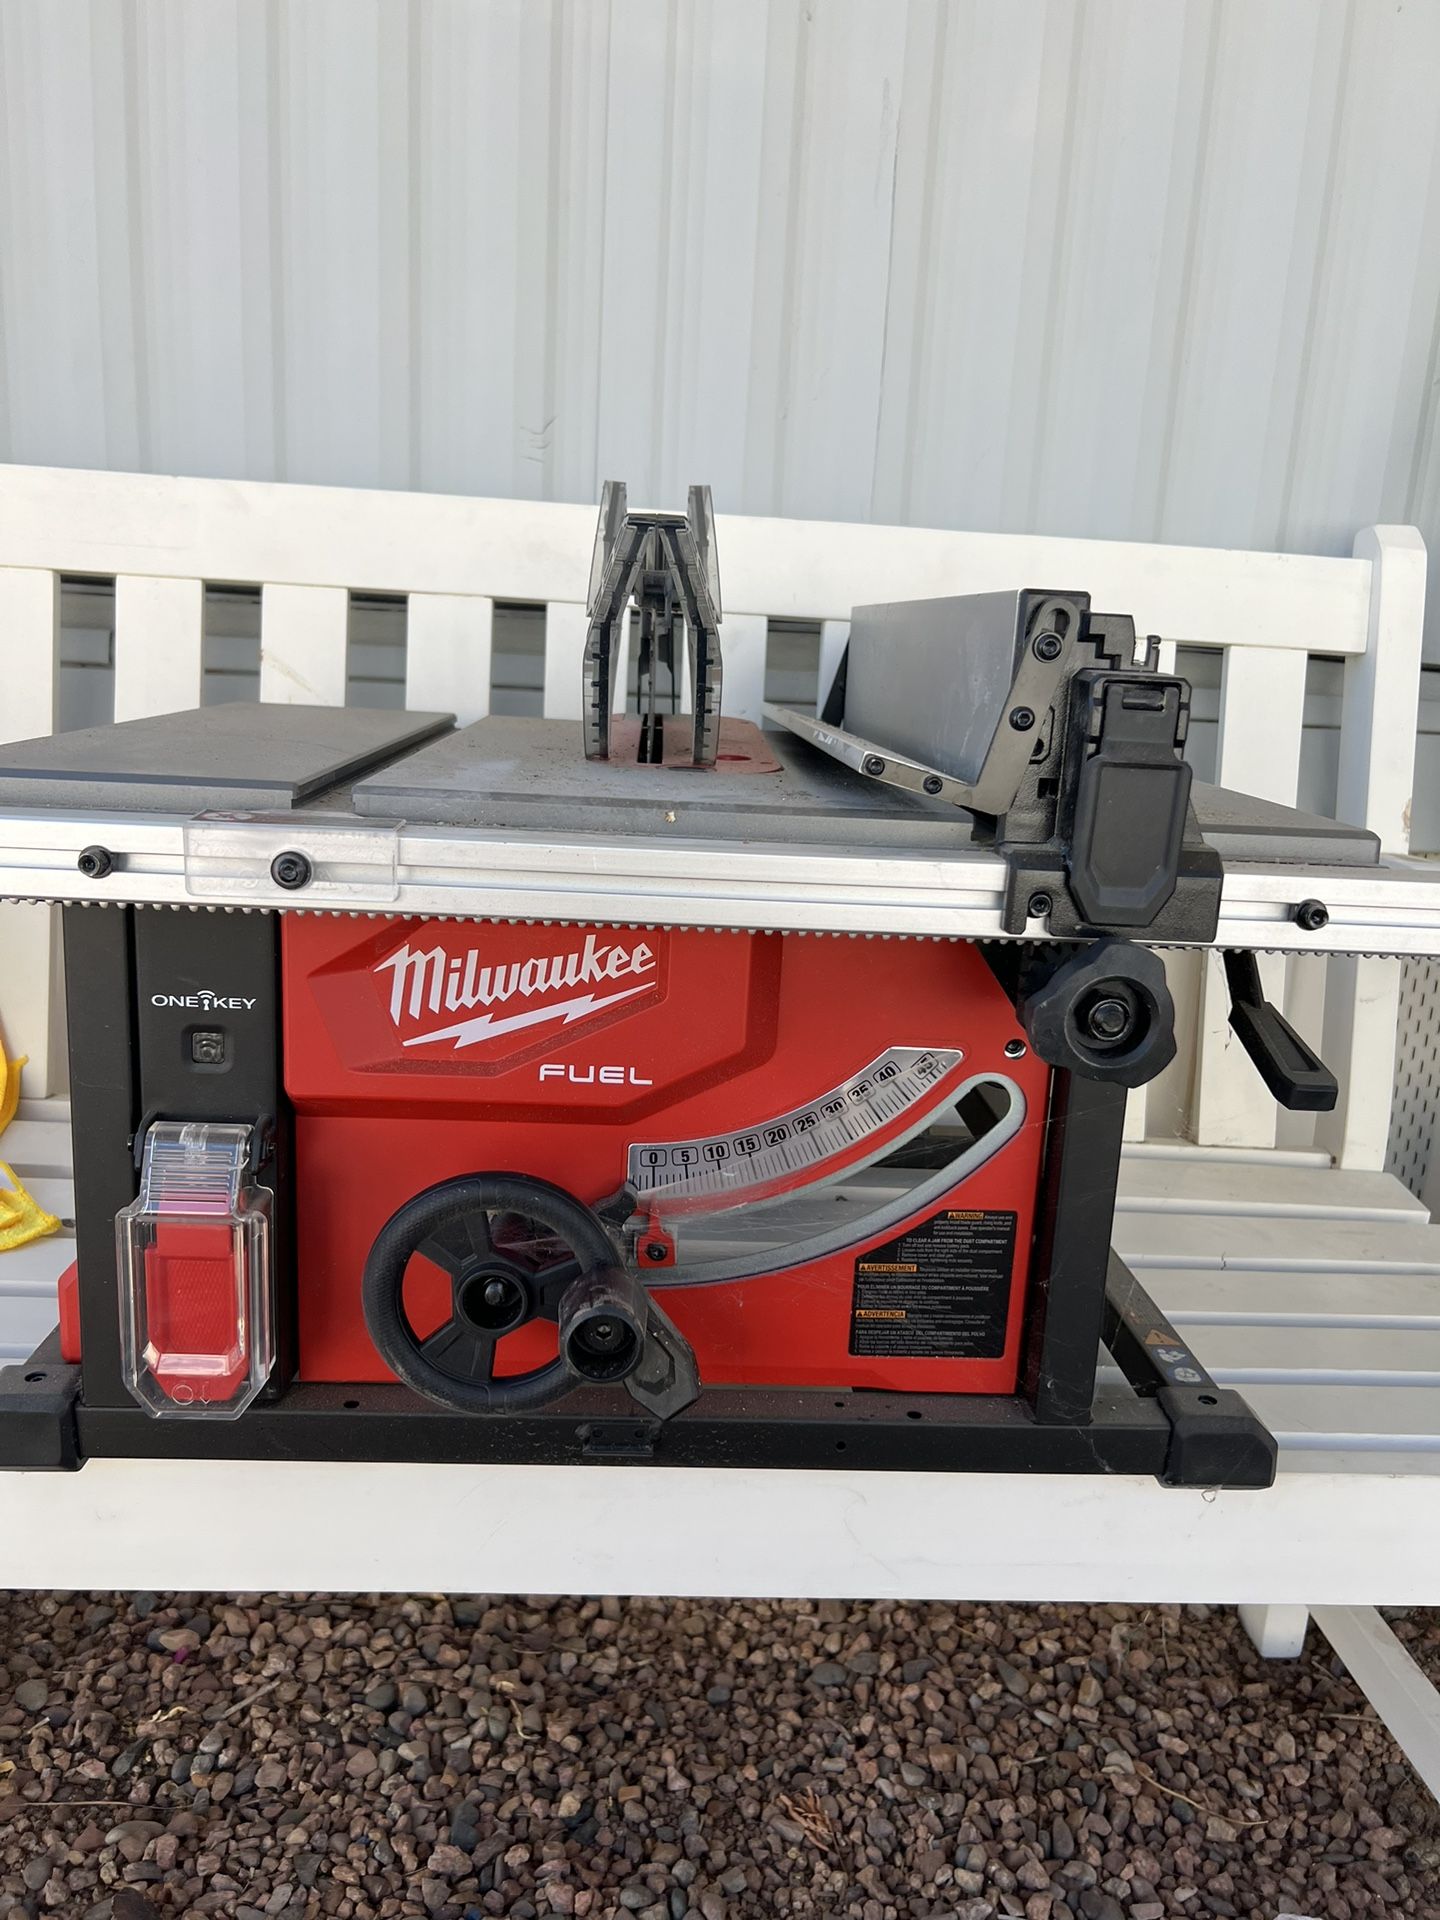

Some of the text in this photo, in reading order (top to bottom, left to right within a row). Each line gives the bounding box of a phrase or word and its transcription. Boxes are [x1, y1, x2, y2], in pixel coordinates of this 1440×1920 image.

[374, 934, 656, 1027] Milwaukee
[539, 1064, 653, 1085] FUEL
[649, 1151, 658, 1164] 0
[681, 1150, 690, 1163] 5
[708, 1145, 725, 1159] 10
[738, 1138, 756, 1153] 15
[767, 1127, 787, 1144] 20
[797, 1115, 816, 1133] 25
[877, 1065, 896, 1082] 40
[866, 1264, 916, 1272] AVERTISSEMENT
[863, 1311, 905, 1319] ADVERTENCIA
